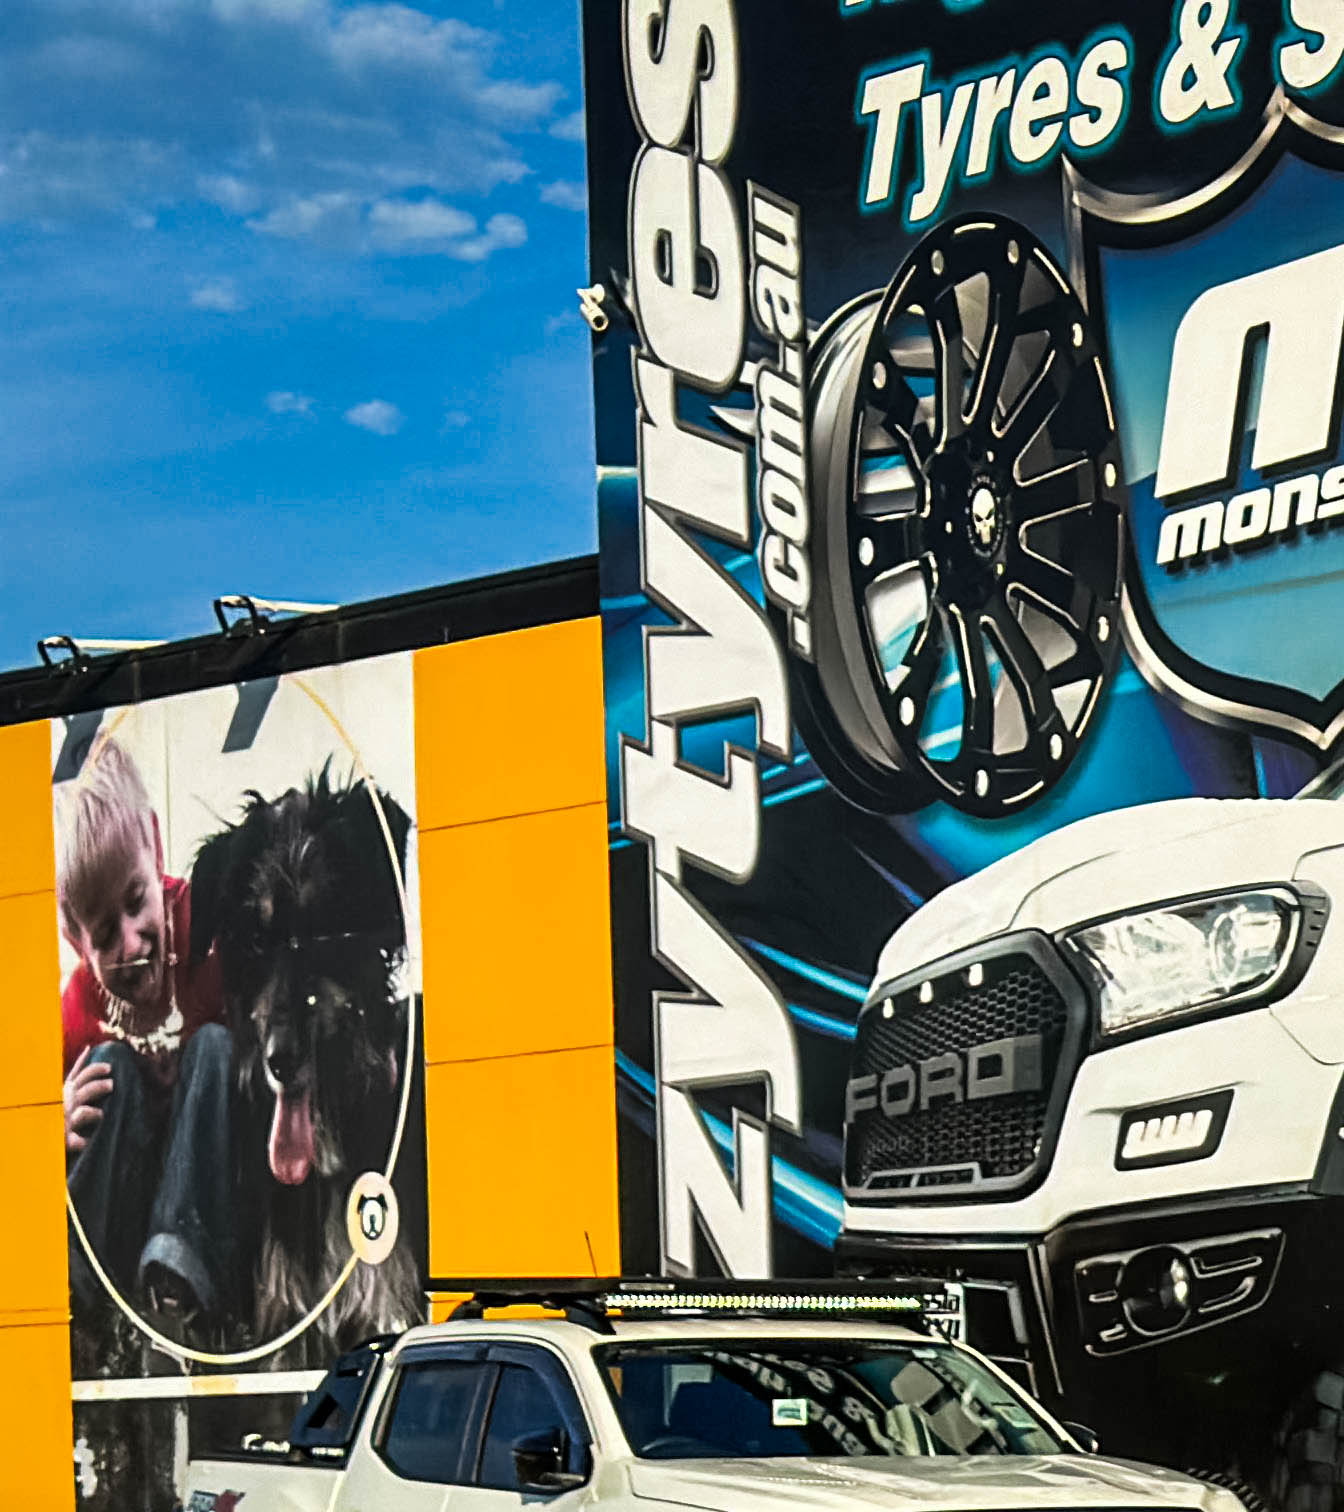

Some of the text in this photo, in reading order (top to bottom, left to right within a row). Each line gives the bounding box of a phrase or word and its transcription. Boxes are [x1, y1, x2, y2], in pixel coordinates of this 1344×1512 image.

[861, 38, 1128, 222] Tyres
[1160, 0, 1240, 123] &
[845, 1036, 1042, 1124] FORD
